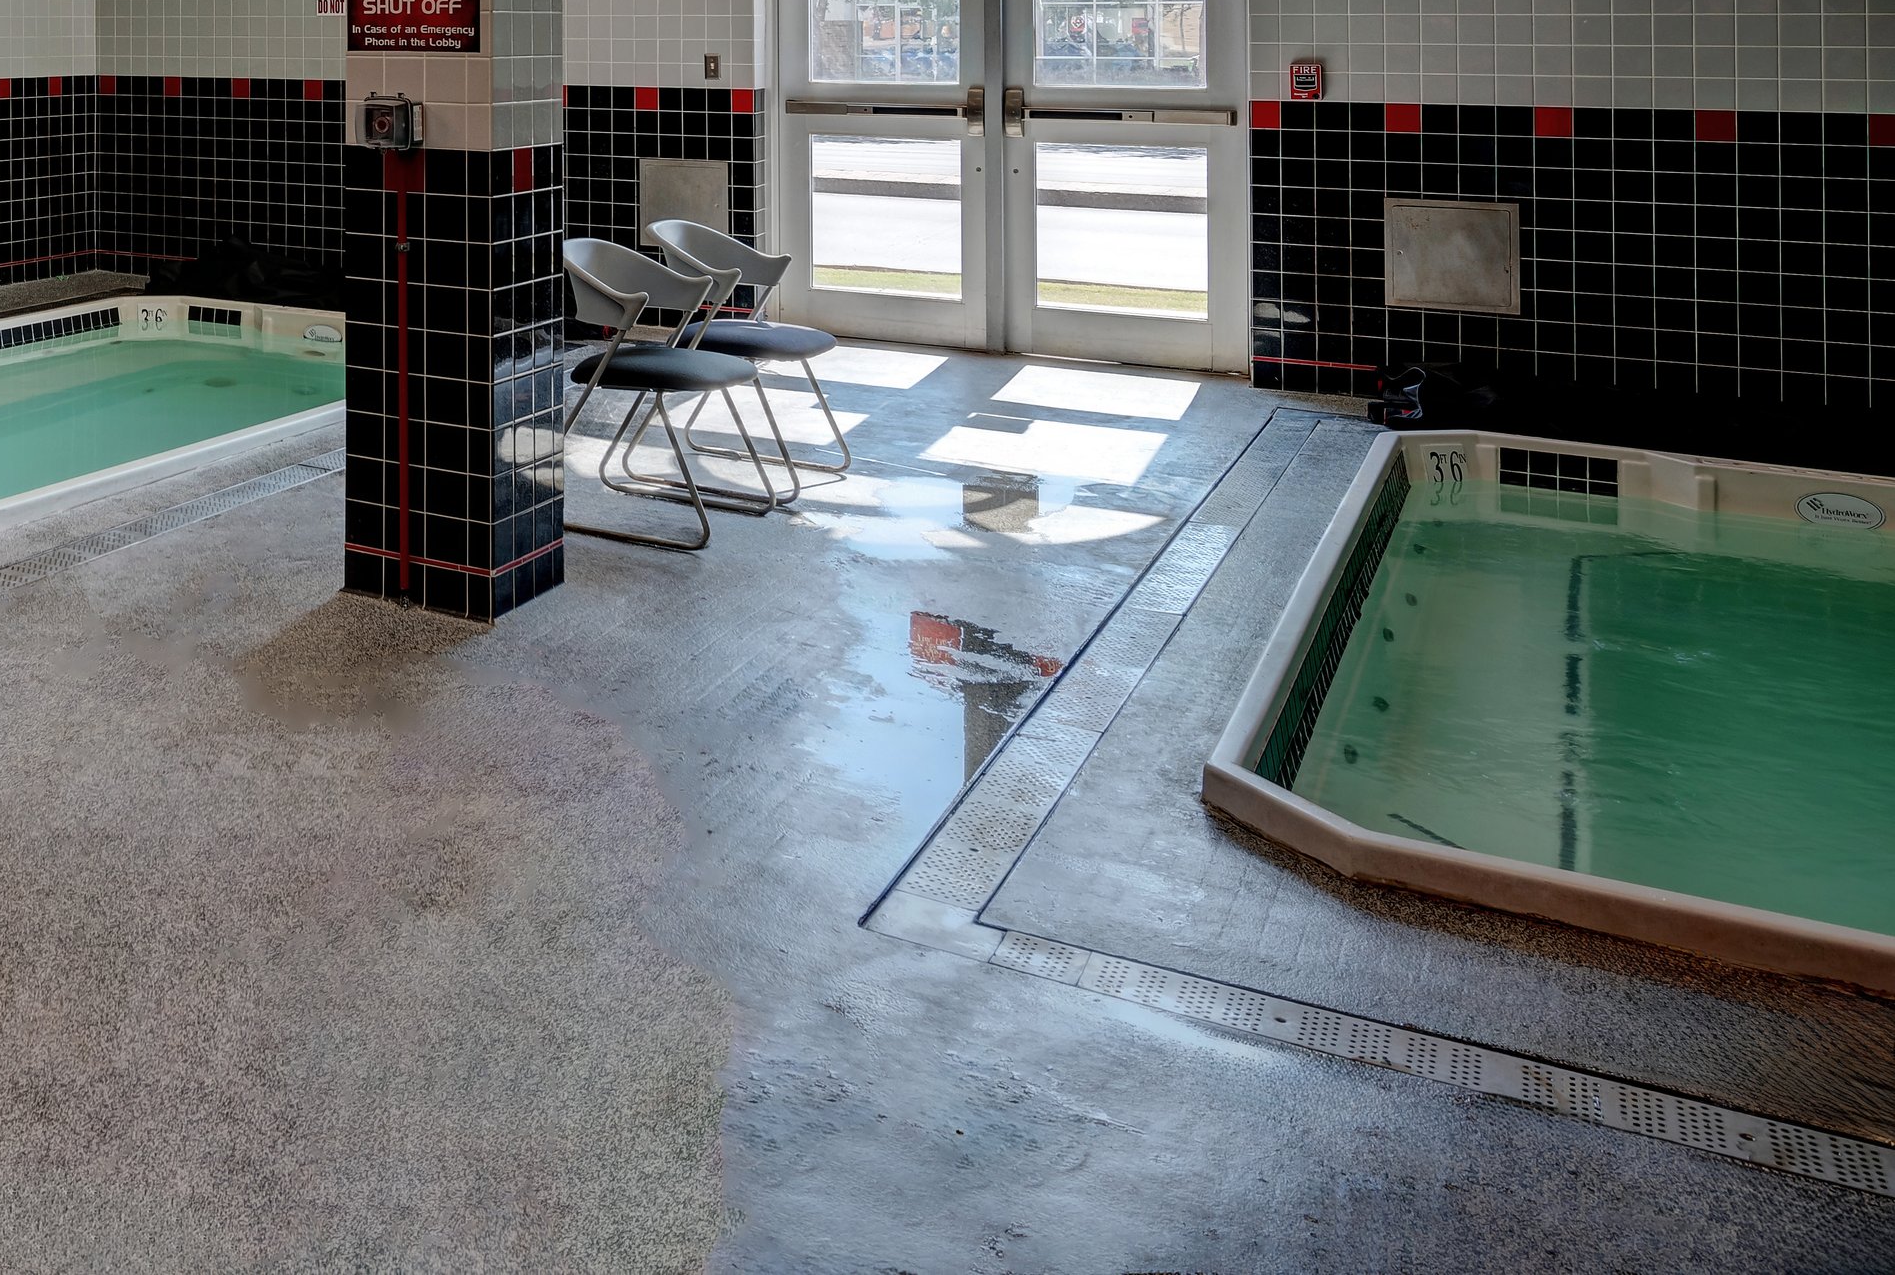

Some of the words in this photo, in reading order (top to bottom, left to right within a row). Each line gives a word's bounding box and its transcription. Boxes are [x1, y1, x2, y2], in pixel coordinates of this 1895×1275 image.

[318, 0, 328, 14] DO
[329, 0, 345, 14] NOT
[352, 25, 361, 34] In
[364, 25, 387, 34] Case
[390, 25, 402, 34] of
[404, 26, 417, 34] an
[420, 25, 475, 36] Emergency
[364, 37, 396, 46] Phone
[398, 37, 408, 46] in
[410, 37, 426, 46] the
[429, 38, 462, 49] Lobby
[1293, 66, 1317, 74] FIRE
